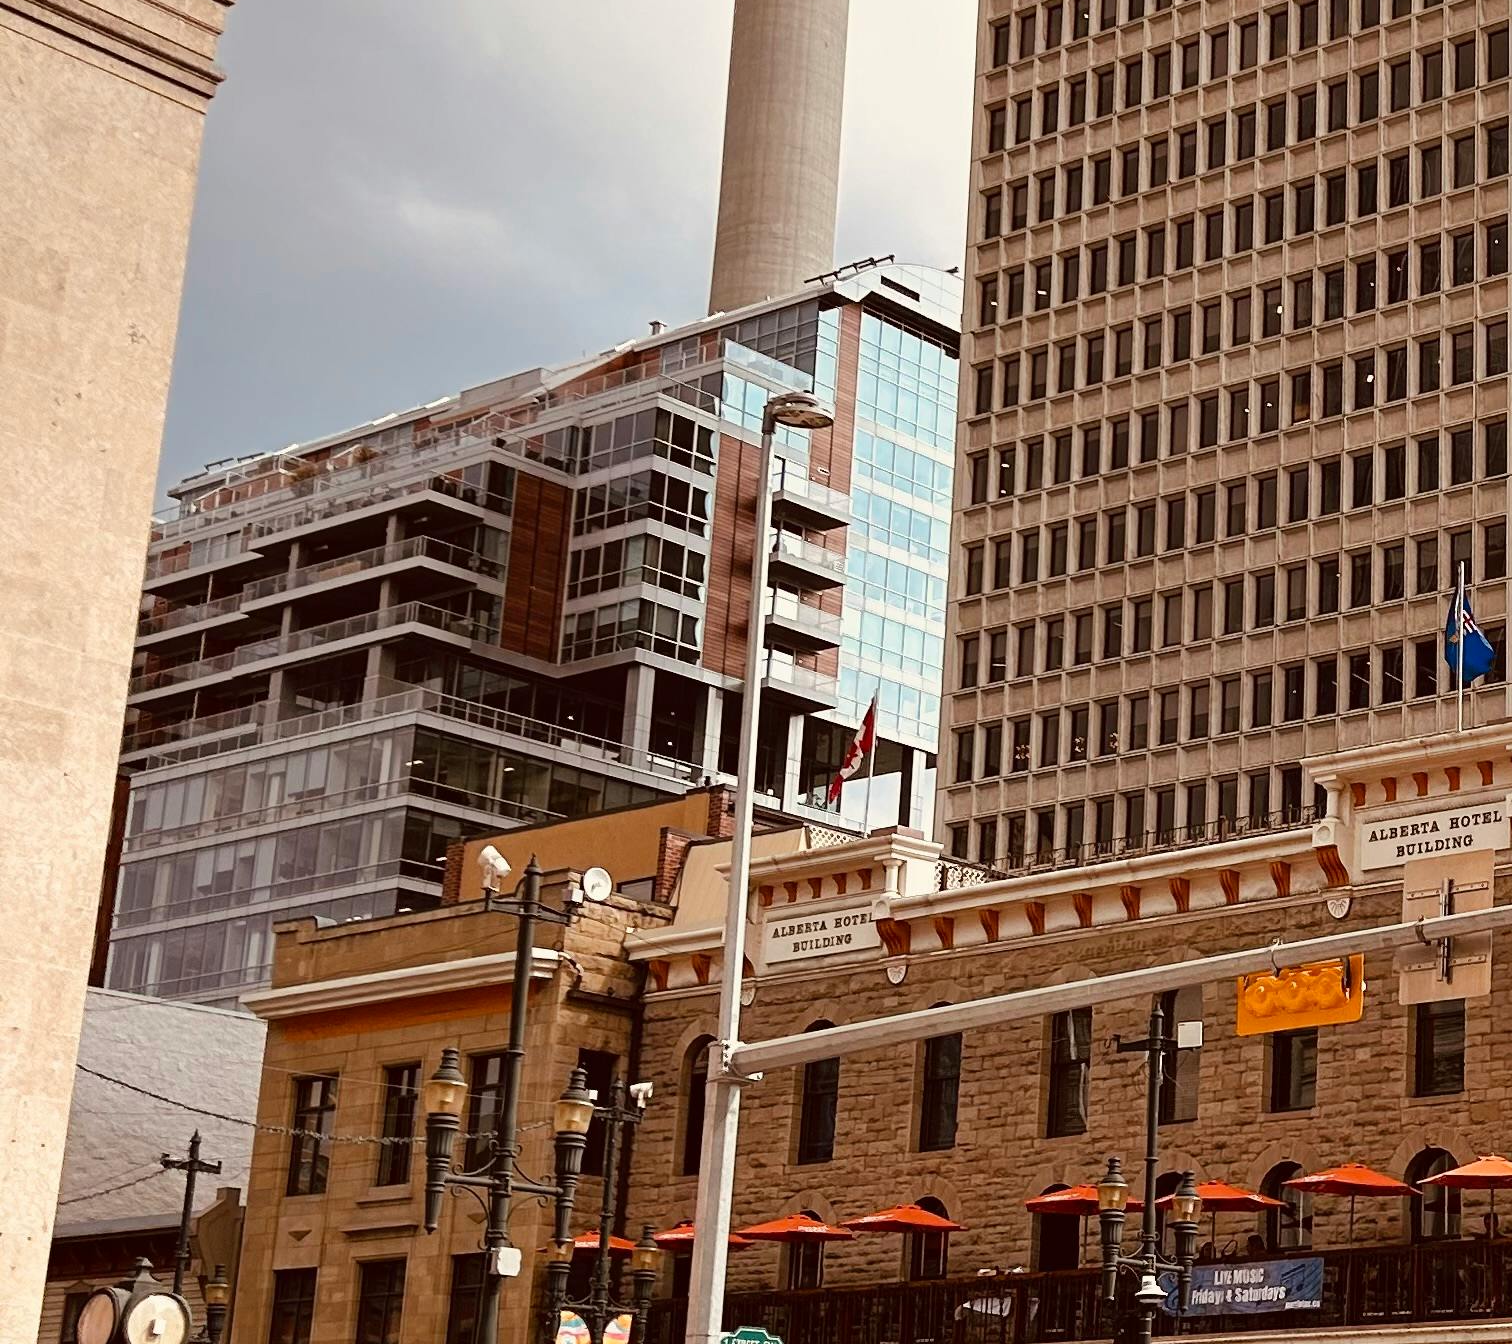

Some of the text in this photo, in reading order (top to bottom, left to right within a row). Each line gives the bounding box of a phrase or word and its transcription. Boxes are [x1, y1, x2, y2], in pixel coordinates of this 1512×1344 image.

[1368, 810, 1502, 843] ALBERTA HOTEL
[1396, 834, 1474, 857] BUILDING
[772, 912, 876, 938] ALBERTA HOTEL
[792, 933, 852, 953] BUILDING
[1214, 1268, 1265, 1286] LIVE MUSIC
[1234, 1285, 1286, 1303] Saturdays
